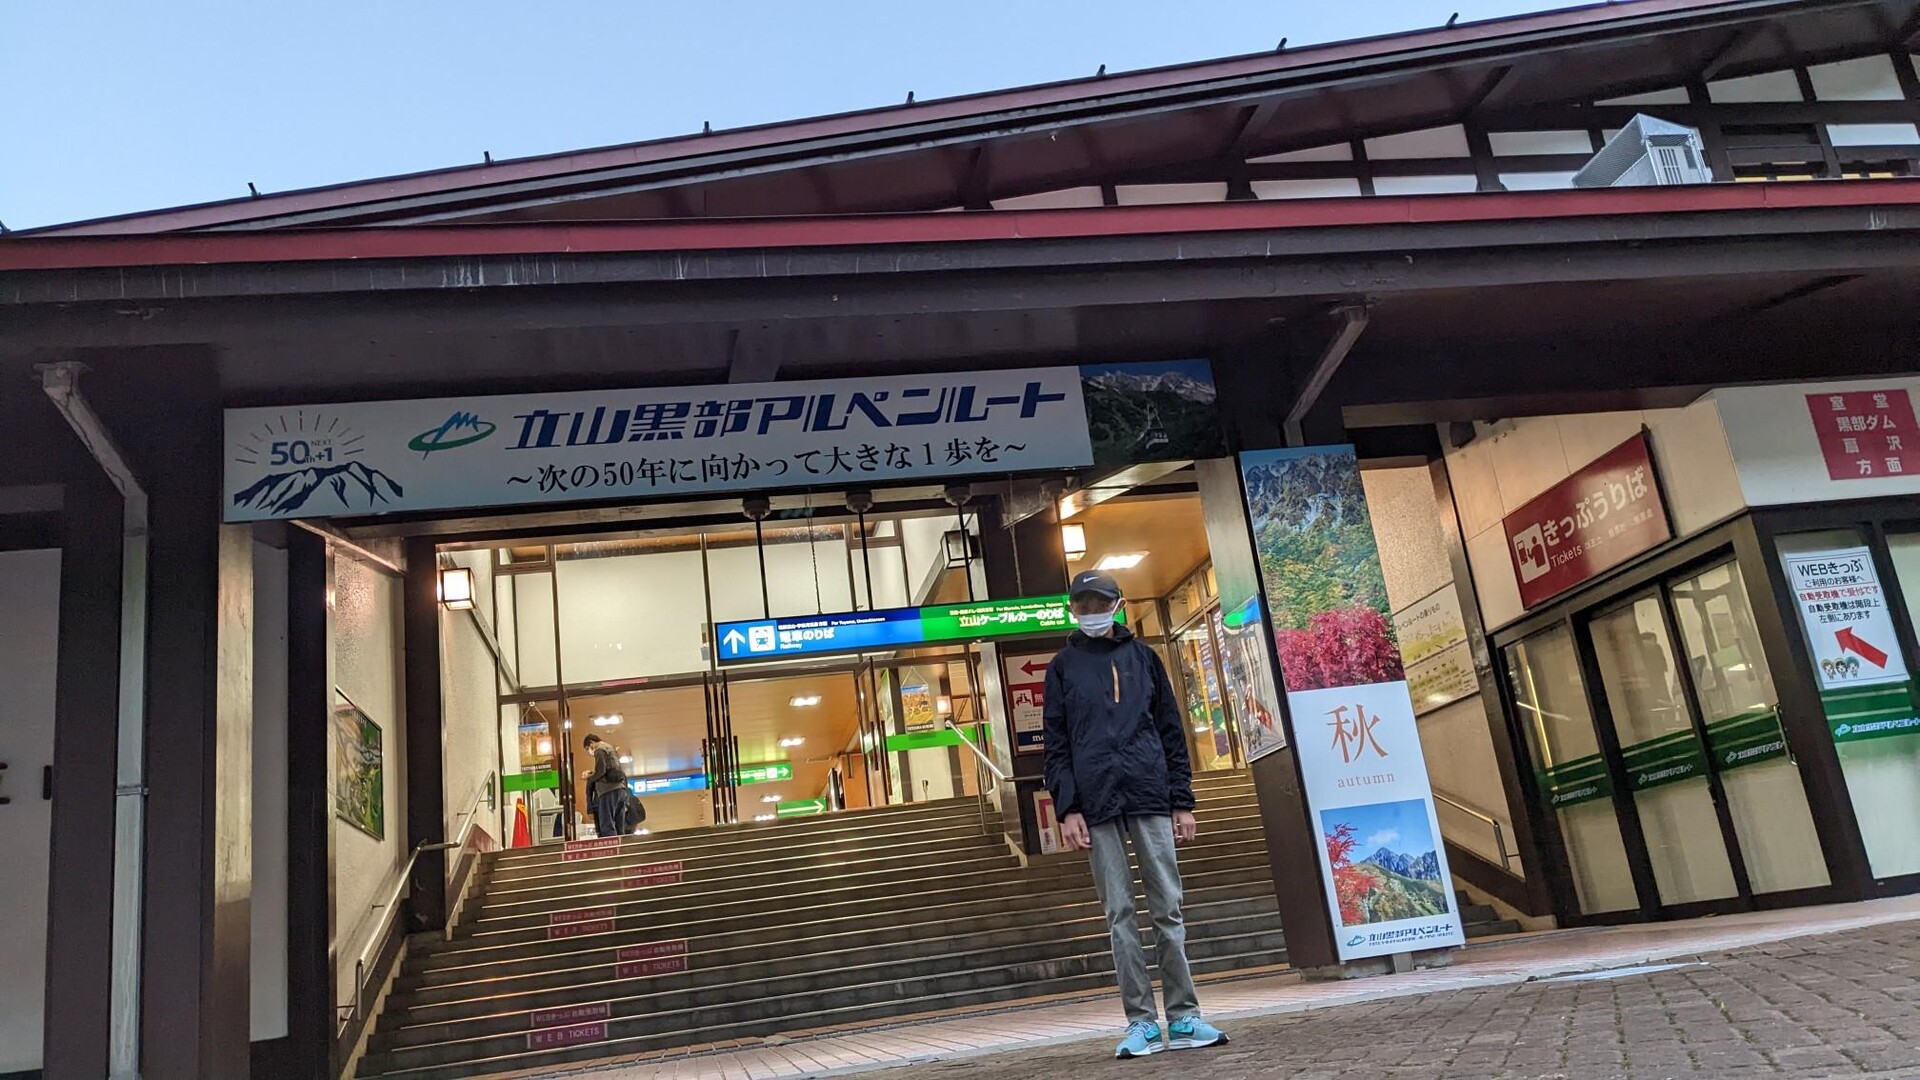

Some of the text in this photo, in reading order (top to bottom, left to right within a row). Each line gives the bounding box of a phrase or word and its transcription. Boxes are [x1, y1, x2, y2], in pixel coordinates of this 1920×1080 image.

[505, 382, 1066, 450] 立山黒部アルペンルート
[1836, 415, 1896, 432] 黒部ダム
[1856, 457, 1902, 475] 方面
[1542, 465, 1648, 547] きっぷうりば
[1550, 545, 1583, 568] Tickets
[1797, 559, 1864, 577] WEBきっぷ
[1805, 575, 1865, 588] ご利用のお客様へ
[1799, 585, 1879, 602] 自動受取機で受付です
[1807, 598, 1880, 614] 自動受取機は階段上
[958, 607, 1065, 628] 立山ケーブルカーのりば
[1819, 610, 1871, 624] 左側にあります
[1324, 704, 1389, 764] 秋
[1337, 773, 1395, 789] autumn
[569, 1026, 600, 1040] TICKETS
